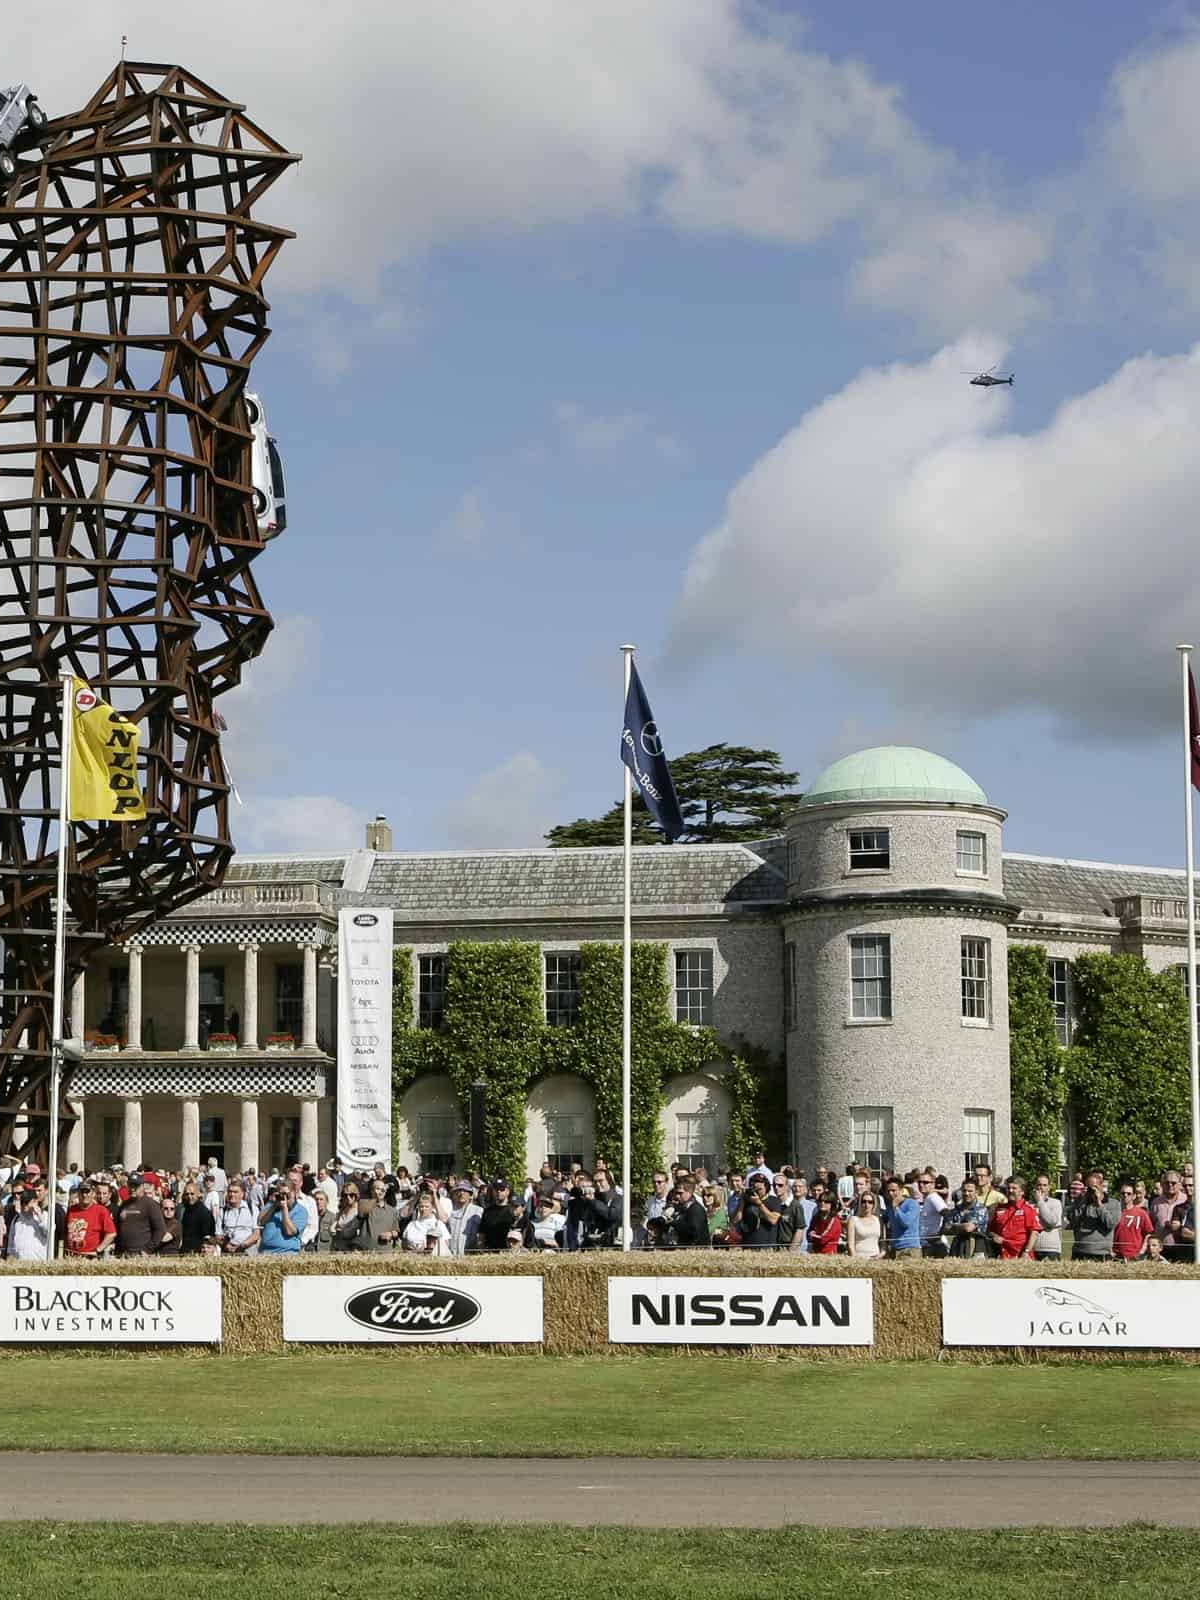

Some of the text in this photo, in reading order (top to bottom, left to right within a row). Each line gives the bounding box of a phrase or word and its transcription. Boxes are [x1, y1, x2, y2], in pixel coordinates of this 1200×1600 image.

[371, 1290, 455, 1324] Ford
[631, 1294, 850, 1327] NISSAN
[14, 1317, 175, 1331] INVESTMENTS
[1029, 1321, 1128, 1337] JAGUAR
